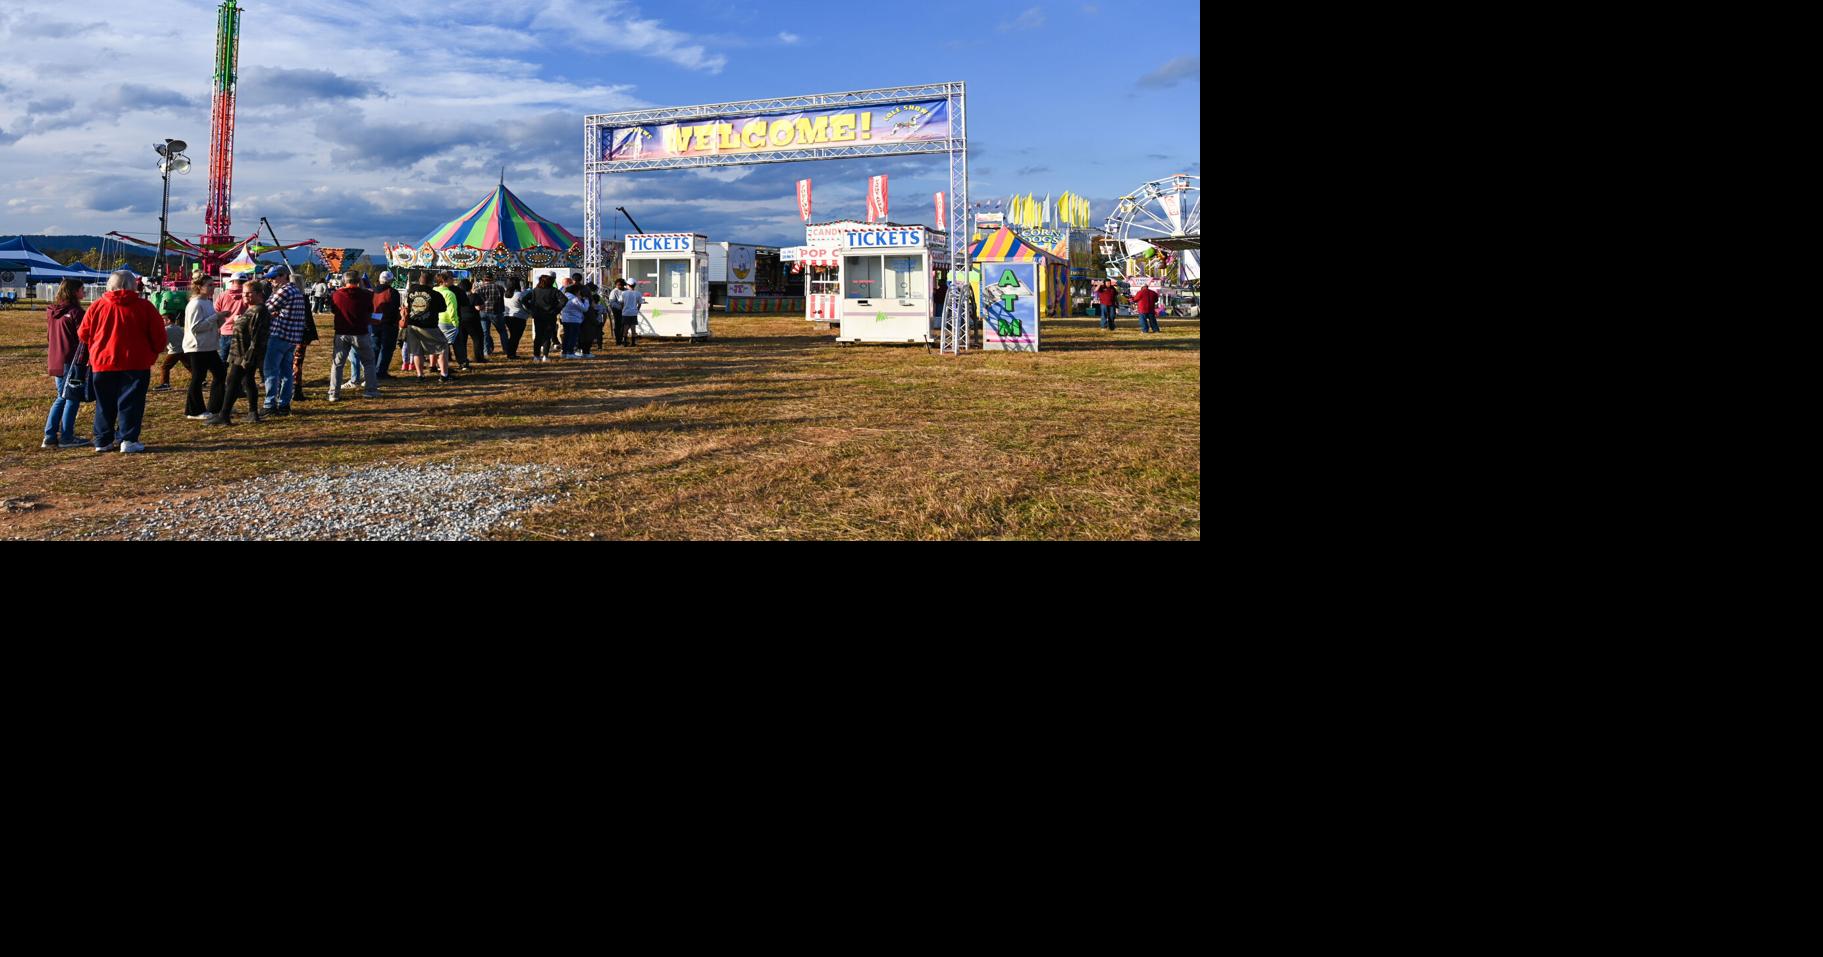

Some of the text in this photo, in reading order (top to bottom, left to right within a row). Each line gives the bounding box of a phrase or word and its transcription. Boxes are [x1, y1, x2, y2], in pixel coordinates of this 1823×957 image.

[663, 111, 871, 153] WELCOME!
[846, 231, 920, 247] TICKETS
[1021, 229, 1061, 238] CORN
[630, 237, 690, 251] TICKETS
[800, 249, 828, 258] POP
[998, 269, 1022, 336] ATM
